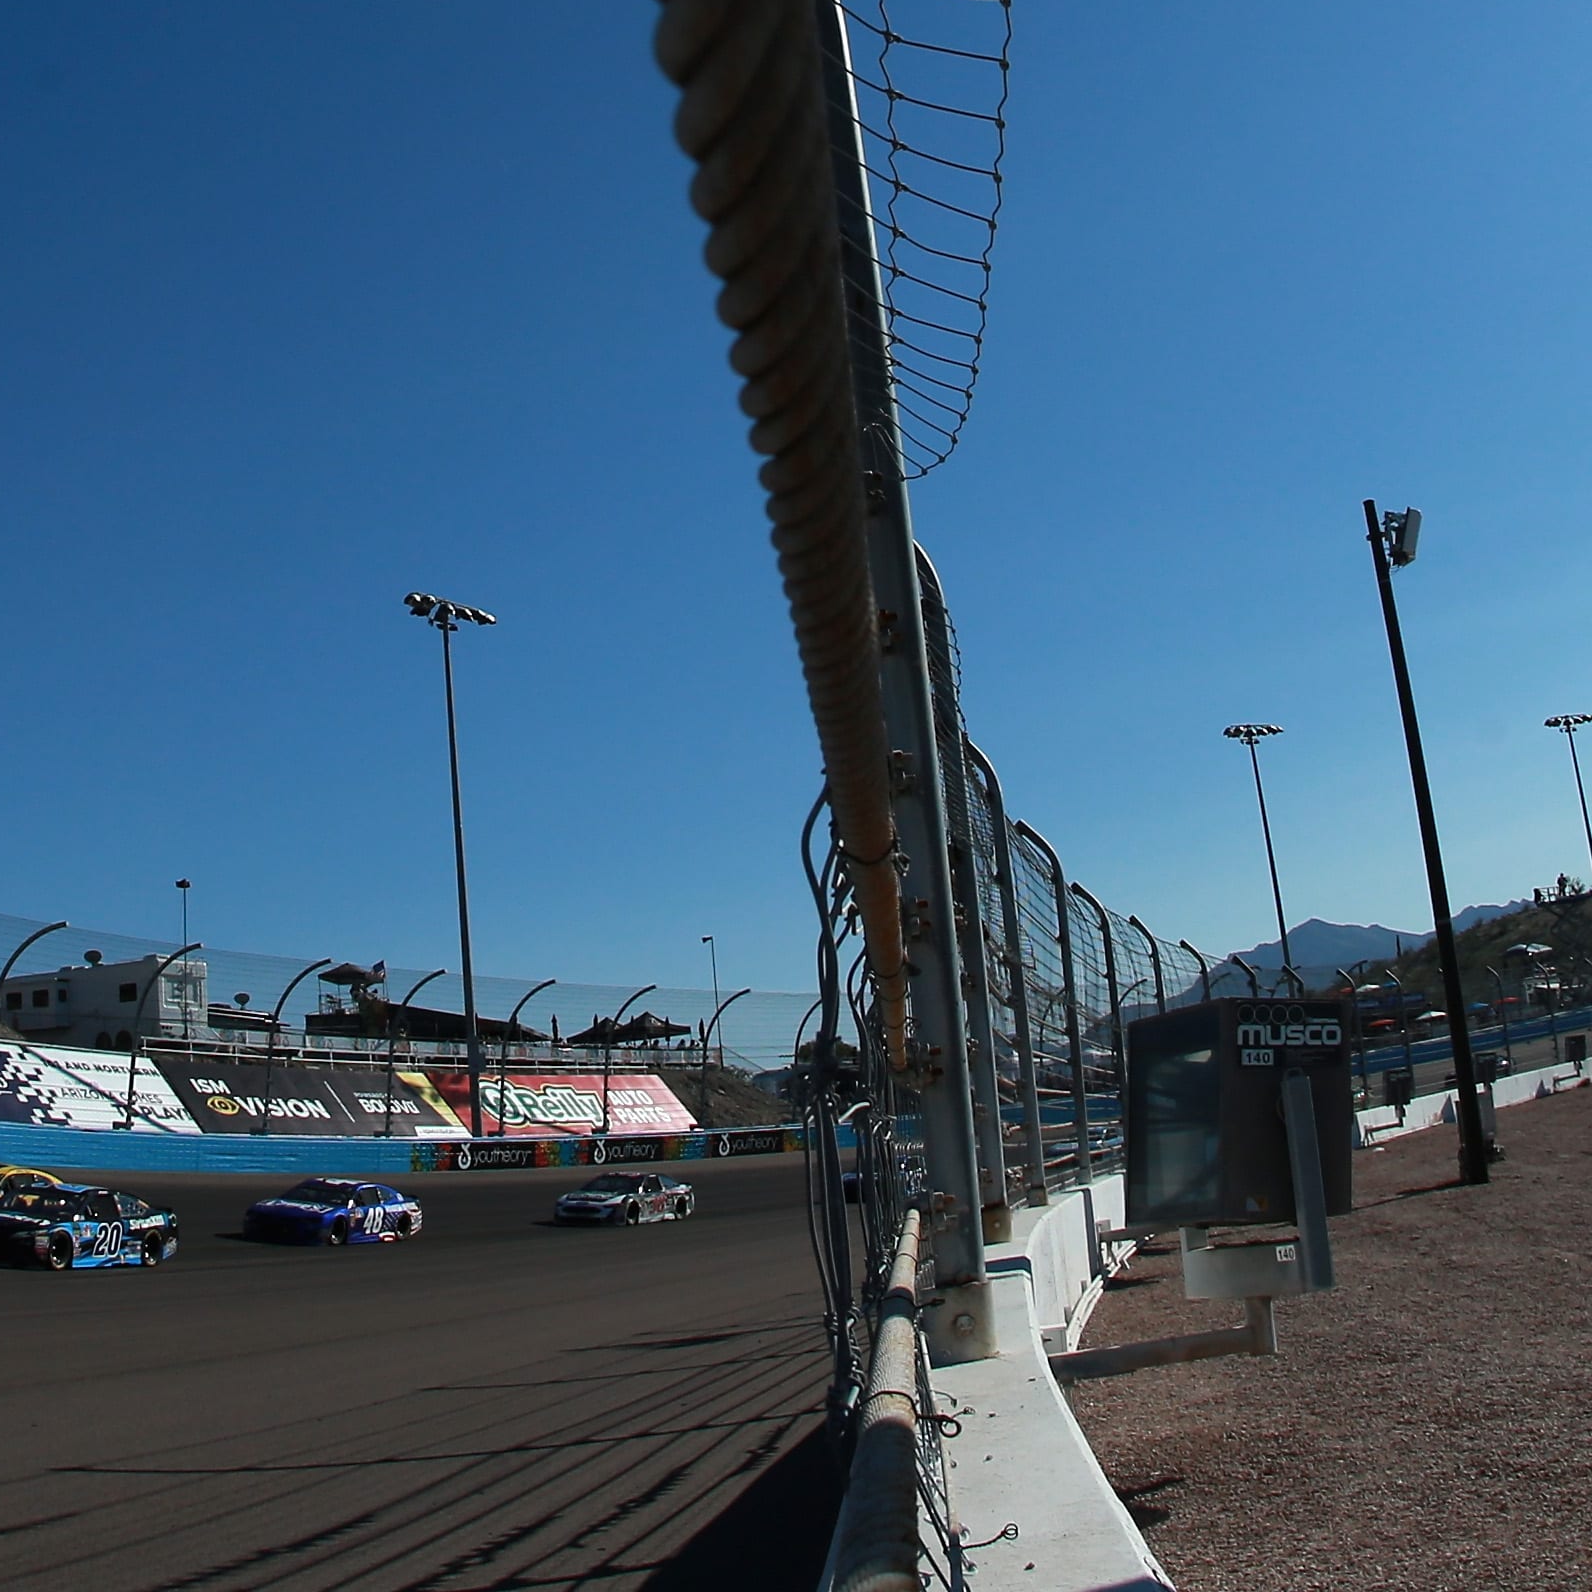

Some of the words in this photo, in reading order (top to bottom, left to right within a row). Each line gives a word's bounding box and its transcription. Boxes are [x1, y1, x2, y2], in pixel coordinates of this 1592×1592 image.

[65, 1062, 91, 1071] AND
[1246, 1052, 1270, 1064] 140
[190, 1078, 231, 1095] ISM
[234, 1096, 331, 1119] VISION
[479, 1077, 607, 1130] O'Reilly
[607, 1089, 654, 1106] AUTO
[613, 1107, 672, 1124] PARTS
[473, 1149, 528, 1168] youtheory
[363, 1207, 384, 1234] 48
[93, 1221, 123, 1258] 20
[1277, 1247, 1295, 1261] 140
